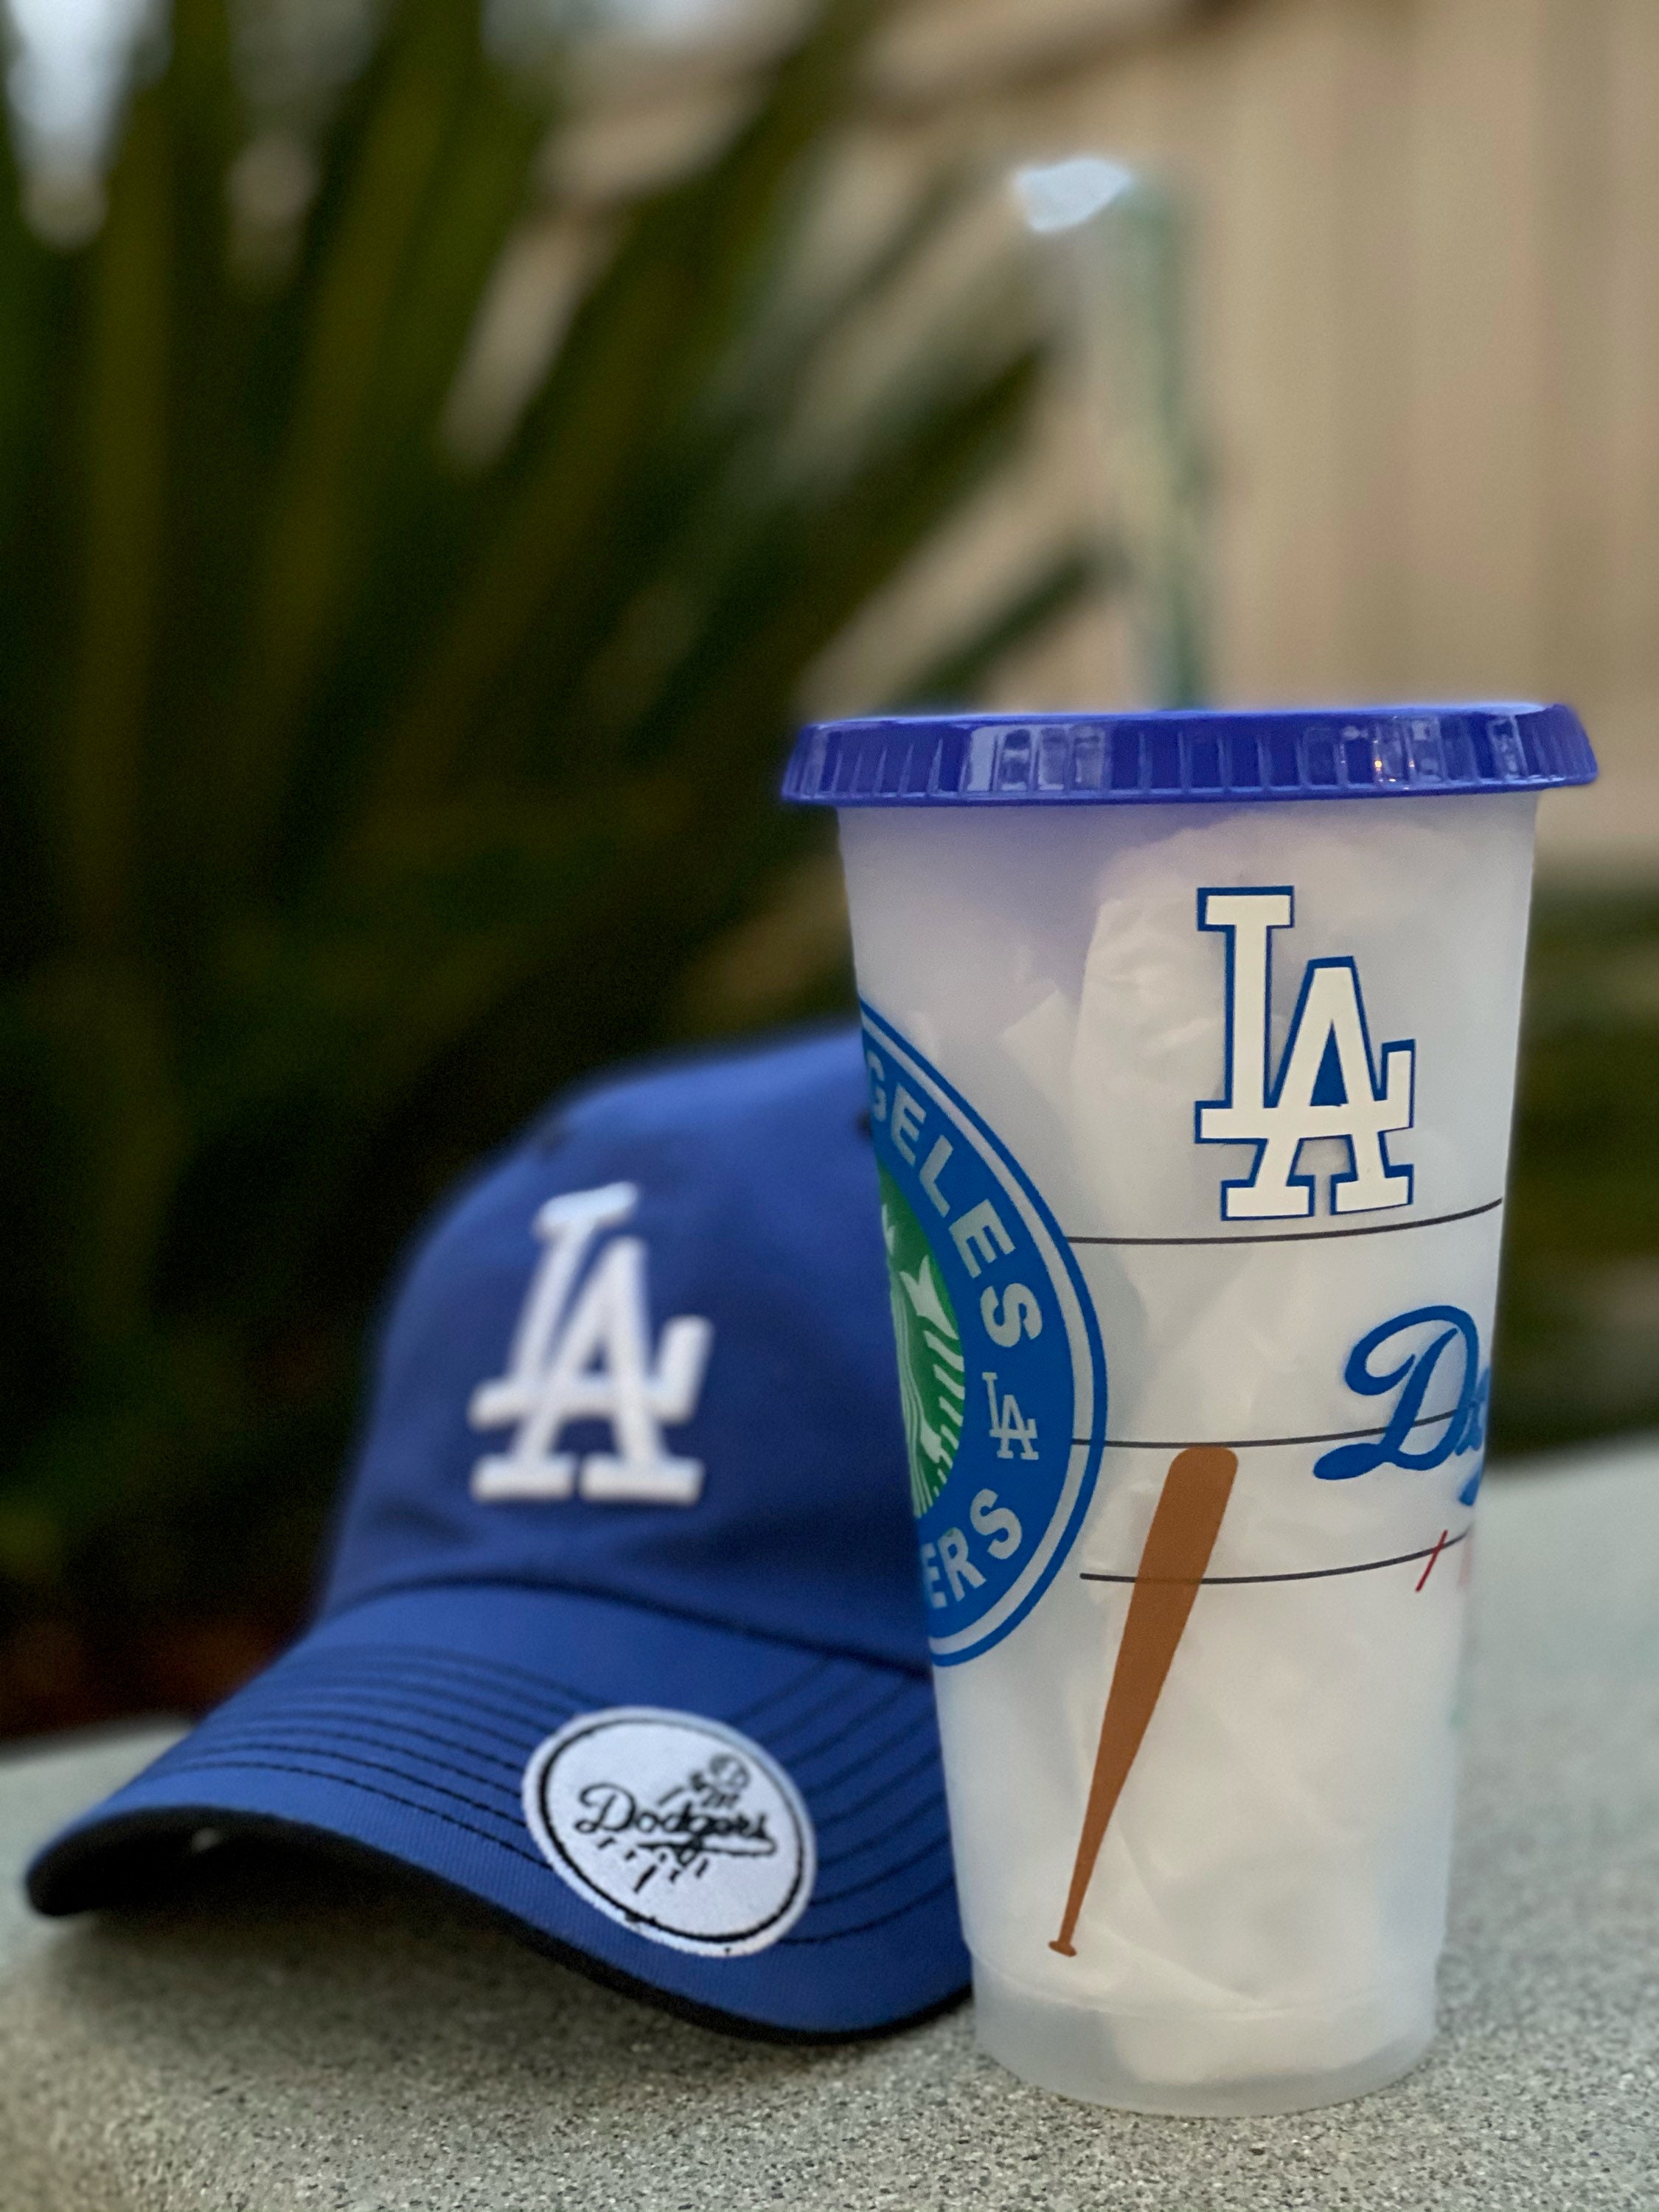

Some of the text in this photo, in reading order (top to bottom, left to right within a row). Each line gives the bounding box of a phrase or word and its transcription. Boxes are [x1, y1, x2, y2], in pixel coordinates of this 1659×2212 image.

[1194, 886, 1416, 1220] LA
[468, 1181, 714, 1506] LA
[982, 1371, 1039, 1460] LA
[574, 1782, 771, 1867] Dodgers
